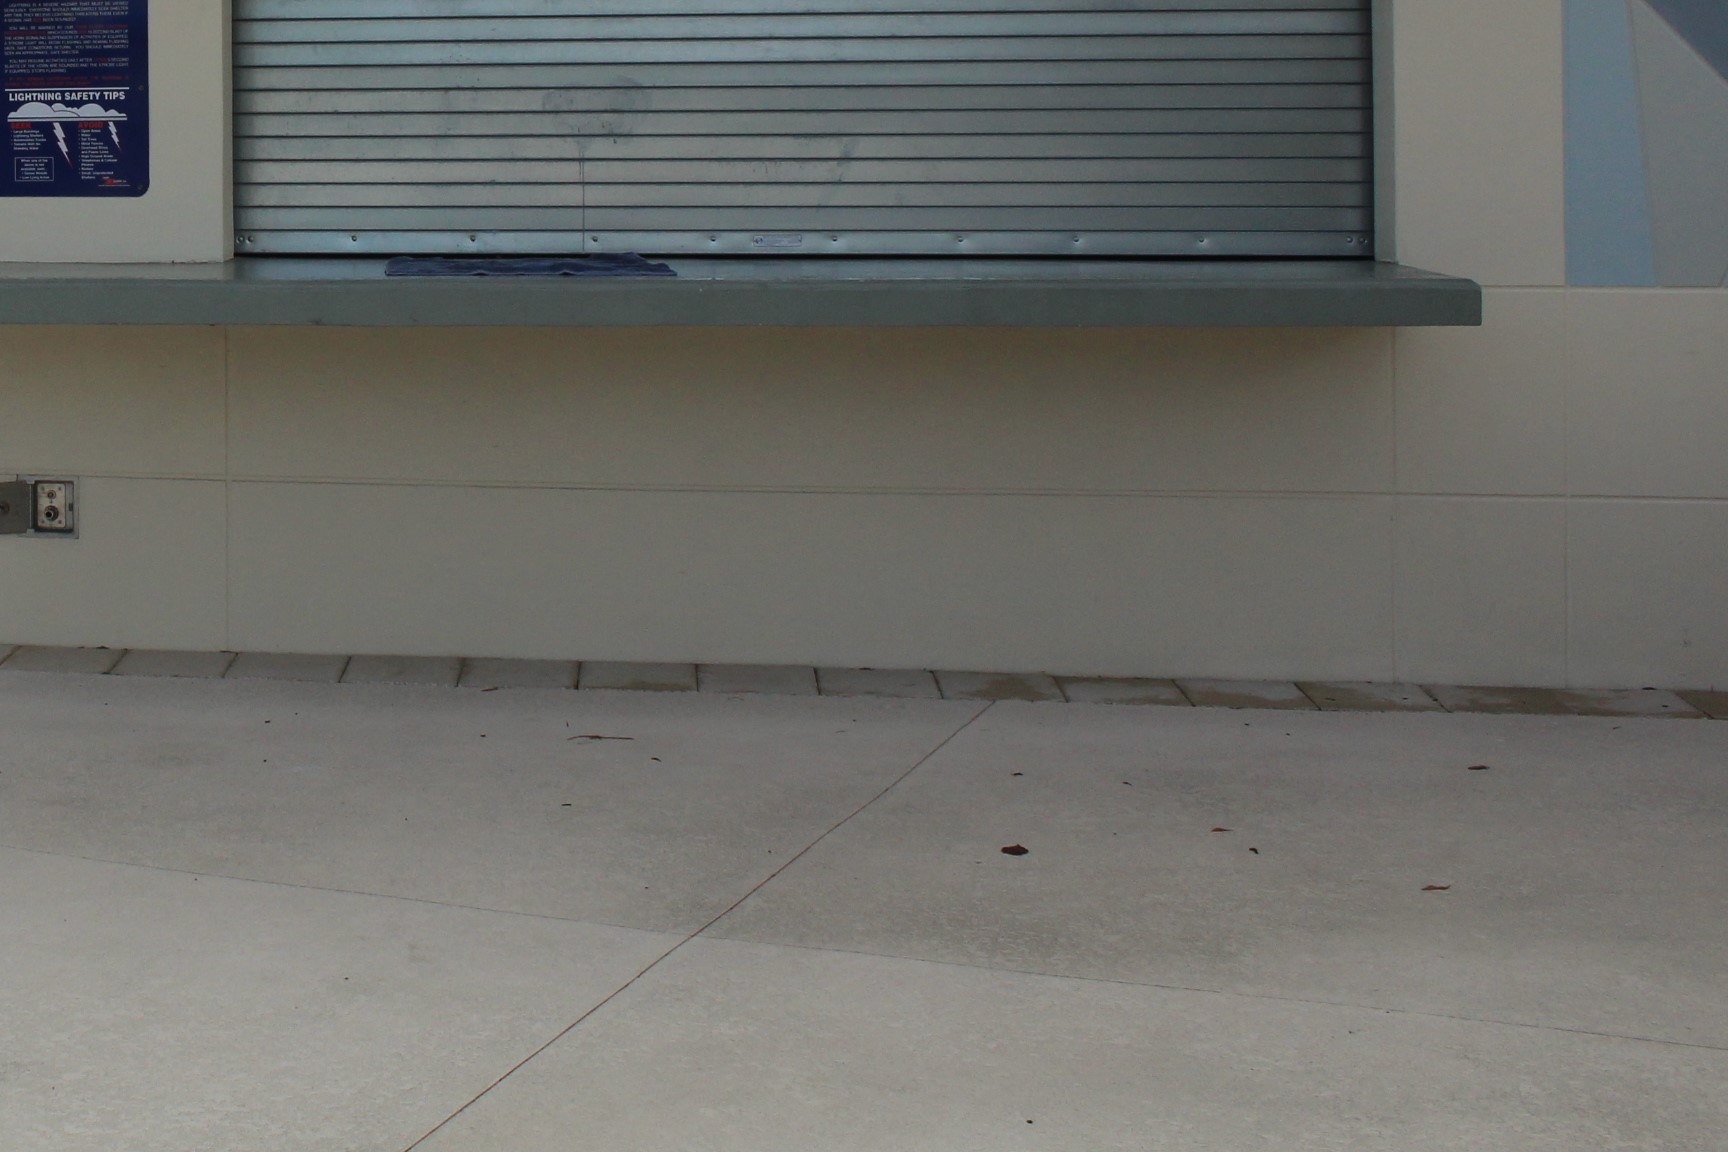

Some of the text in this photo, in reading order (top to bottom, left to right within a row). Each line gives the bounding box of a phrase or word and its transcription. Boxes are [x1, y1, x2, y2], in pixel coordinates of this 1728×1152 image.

[9, 92, 125, 101] LIGHTNING SAFETY TIPS
